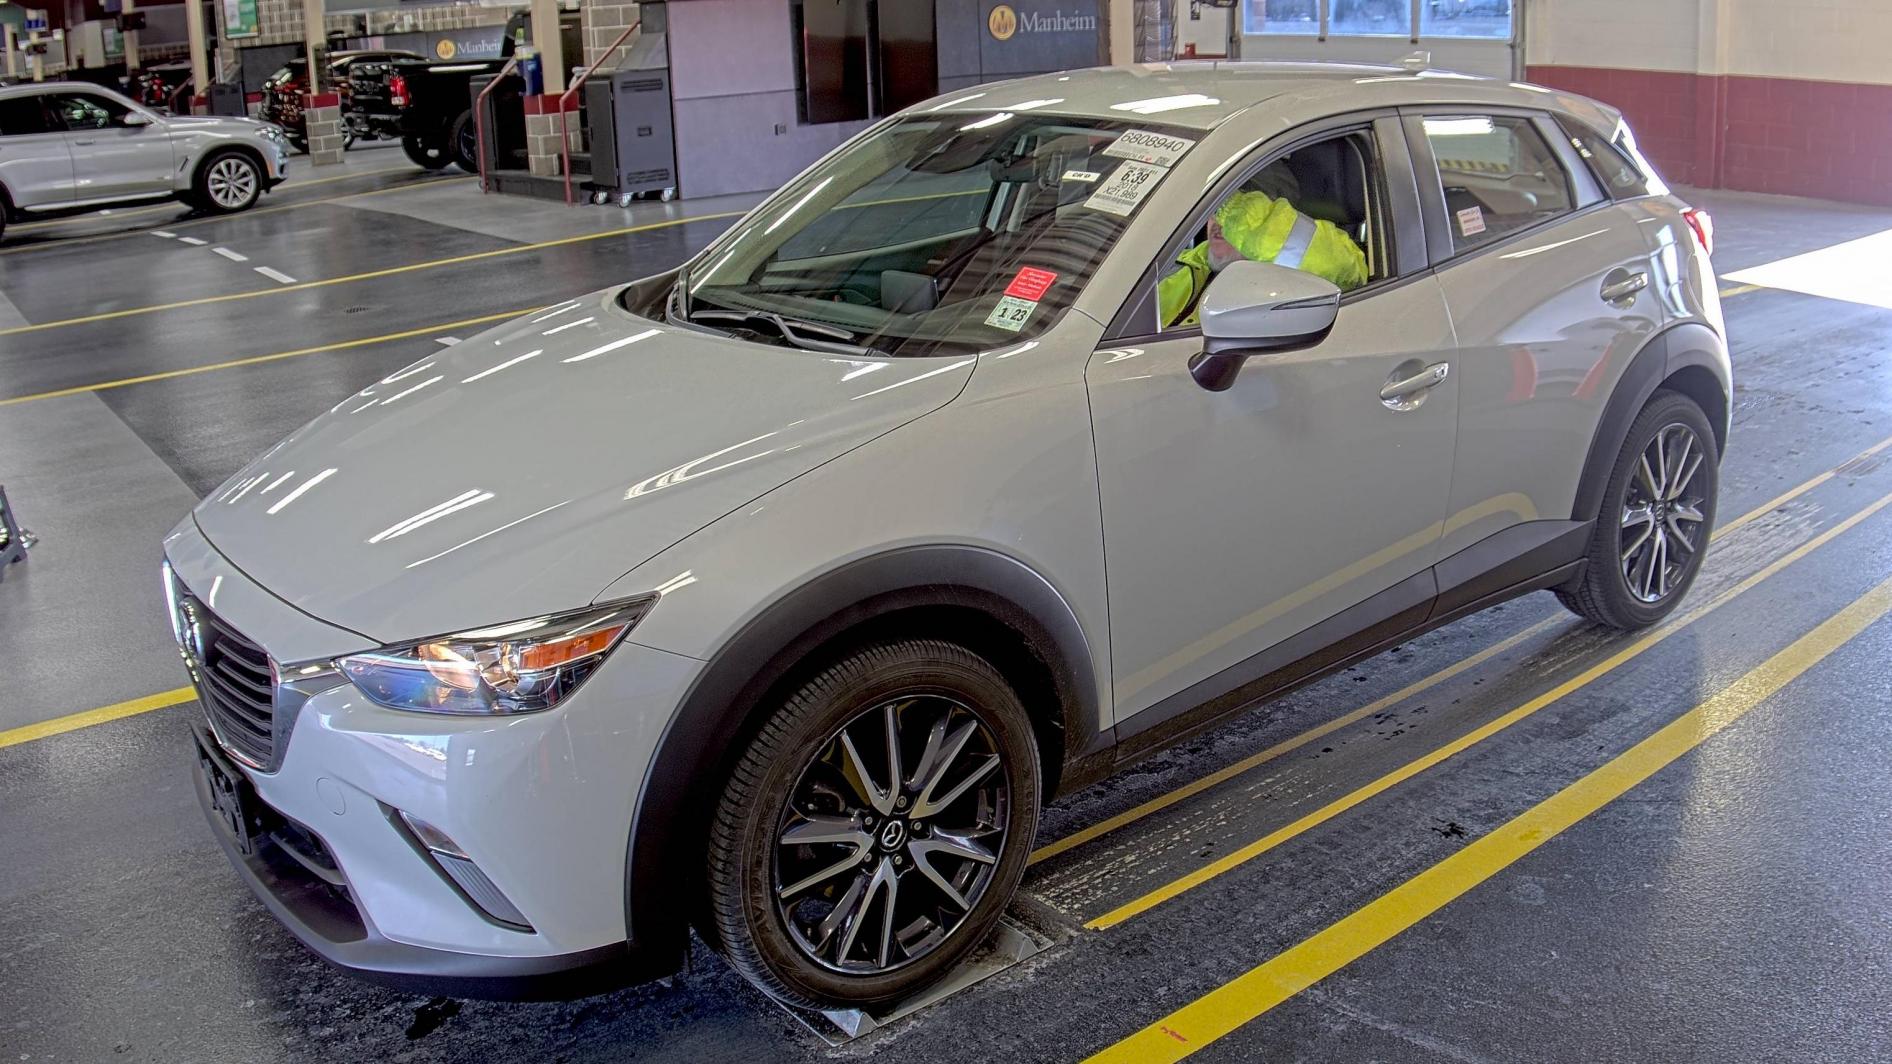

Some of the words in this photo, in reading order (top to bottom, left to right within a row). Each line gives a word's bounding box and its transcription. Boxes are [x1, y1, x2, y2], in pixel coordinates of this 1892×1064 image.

[1019, 9, 1096, 33] Manheim
[1120, 132, 1185, 152] 6808940
[998, 307, 1008, 318] 1
[1010, 308, 1028, 321] 23
